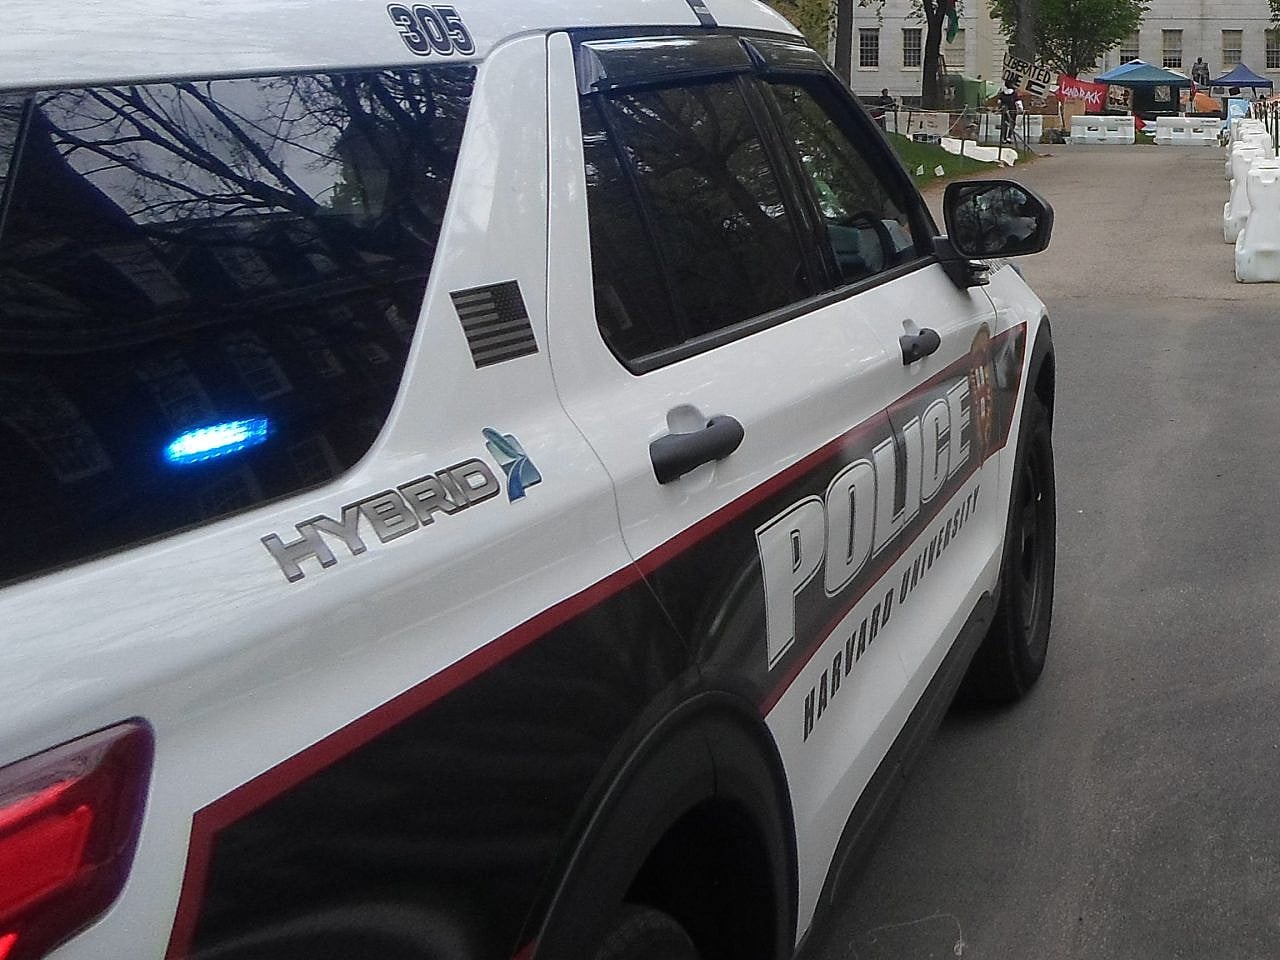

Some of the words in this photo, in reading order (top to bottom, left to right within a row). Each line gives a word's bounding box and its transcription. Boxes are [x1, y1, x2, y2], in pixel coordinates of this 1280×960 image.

[386, 3, 475, 56] 305
[1003, 52, 1051, 84] LIBERATED
[260, 457, 501, 583] HYBRID
[754, 375, 971, 671] POLICE
[803, 588, 894, 742] HARVARD
[899, 484, 980, 604] UNIVERSITY
